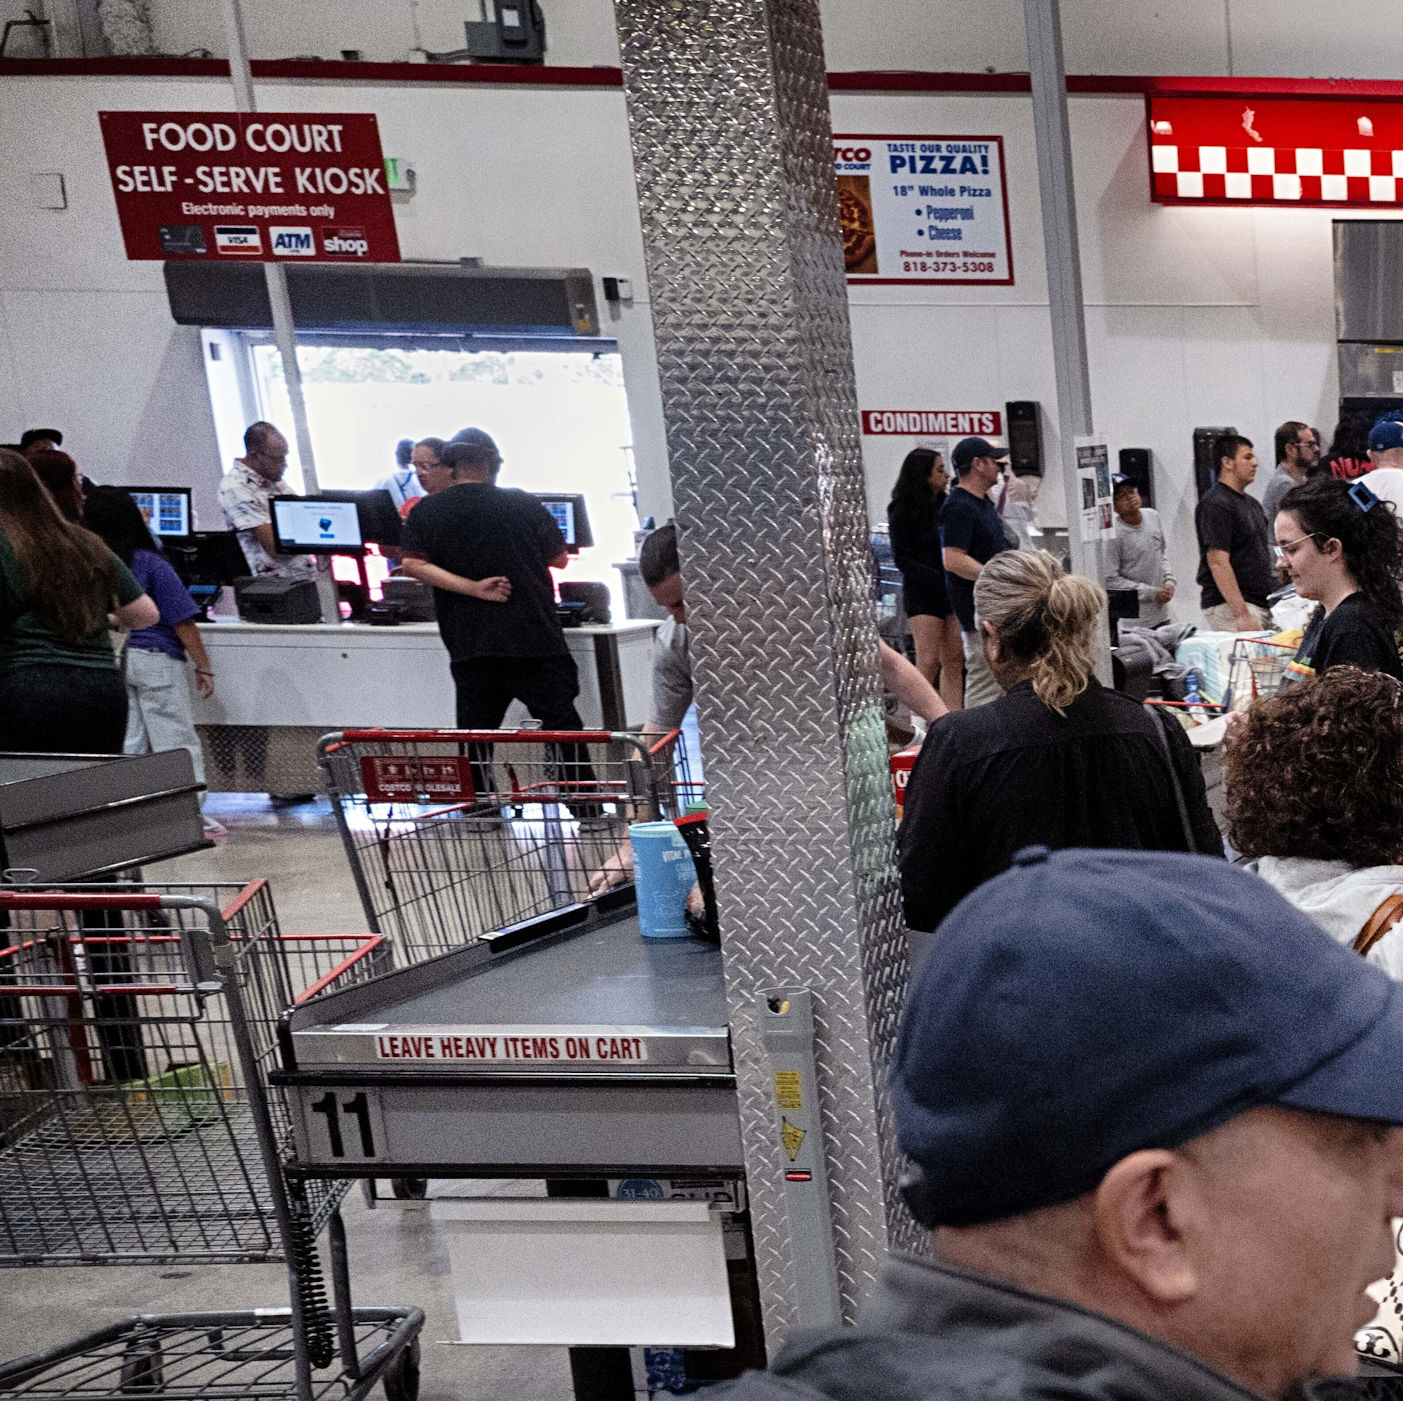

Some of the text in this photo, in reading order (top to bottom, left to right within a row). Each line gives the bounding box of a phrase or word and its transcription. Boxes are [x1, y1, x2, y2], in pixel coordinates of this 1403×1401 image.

[142, 122, 343, 153] FOOD COURT
[887, 143, 989, 154] TASTE OUR QUALITY
[888, 155, 990, 175] PIZZA!
[295, 167, 385, 195] KIOSK
[918, 185, 955, 197] Whole
[960, 186, 991, 197] Pizza
[182, 202, 335, 218] Electronic payments only
[926, 205, 974, 222] Pepperoni
[228, 236, 249, 245] VISA
[275, 233, 311, 249] ATM
[928, 225, 963, 240] Cheese
[324, 238, 369, 257] shop
[903, 261, 994, 272] 818-373-5308
[869, 412, 994, 434] CONDIMENTS
[379, 1037, 642, 1059] LEAVE HEAVY ITEMS ON CART
[313, 1092, 375, 1157] 11
